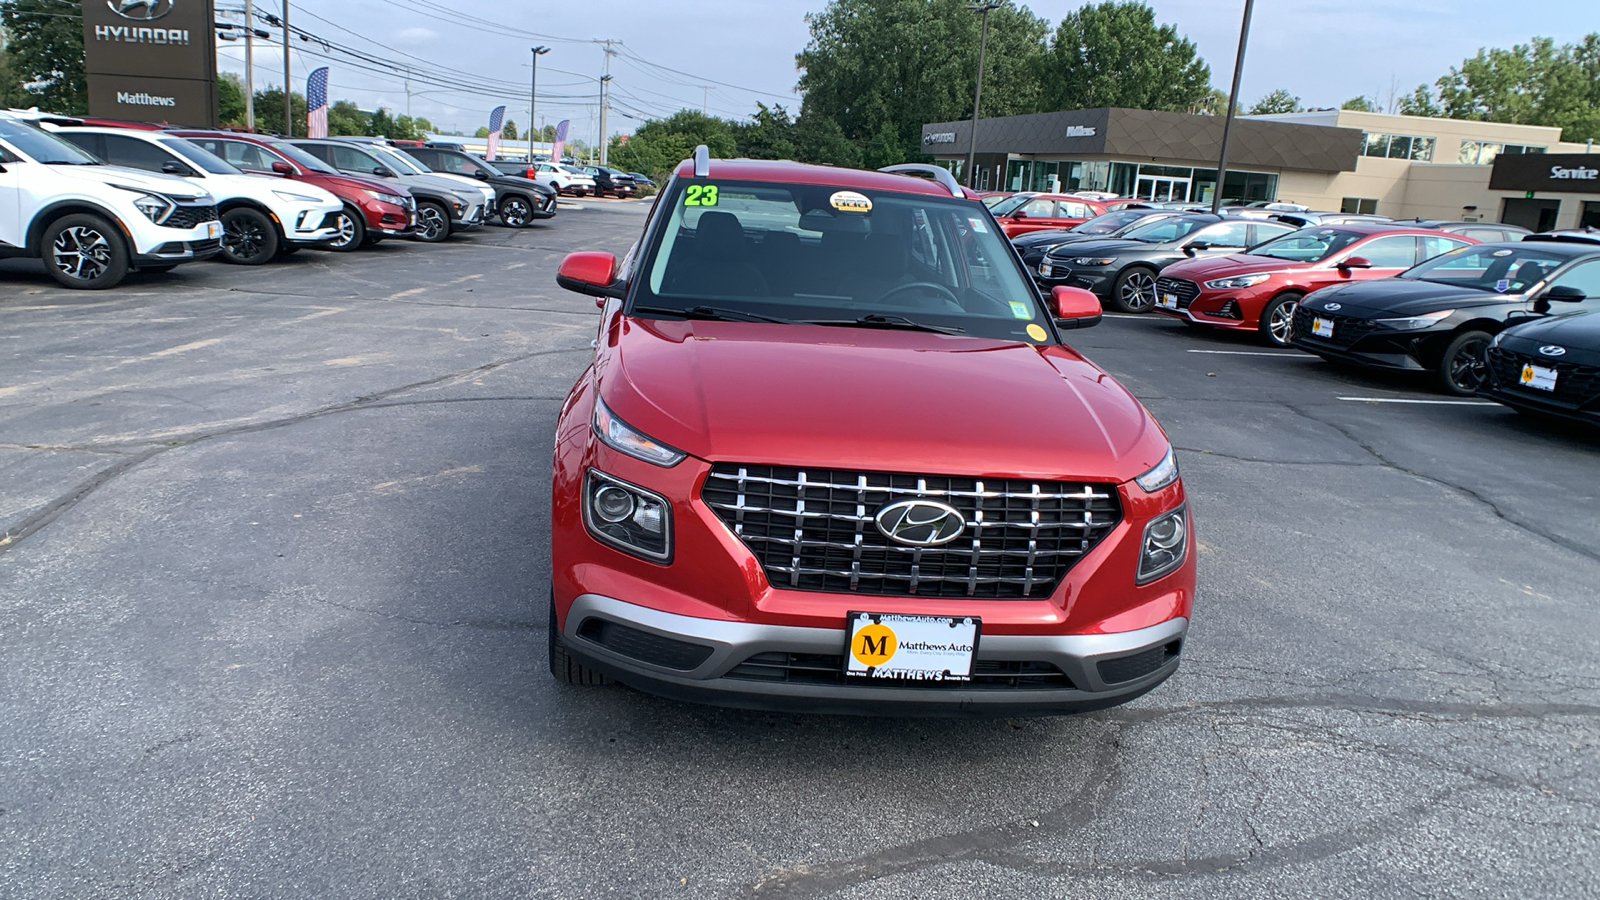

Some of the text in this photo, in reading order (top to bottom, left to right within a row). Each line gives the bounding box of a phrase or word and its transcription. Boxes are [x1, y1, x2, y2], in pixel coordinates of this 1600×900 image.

[94, 24, 190, 45] HYUNDAI
[116, 91, 176, 107] Matthews
[1549, 165, 1599, 179] Service
[684, 184, 718, 206] 23
[859, 635, 889, 656] M
[898, 641, 973, 652] Matthews Auto
[872, 669, 943, 681] MATTHEWS
